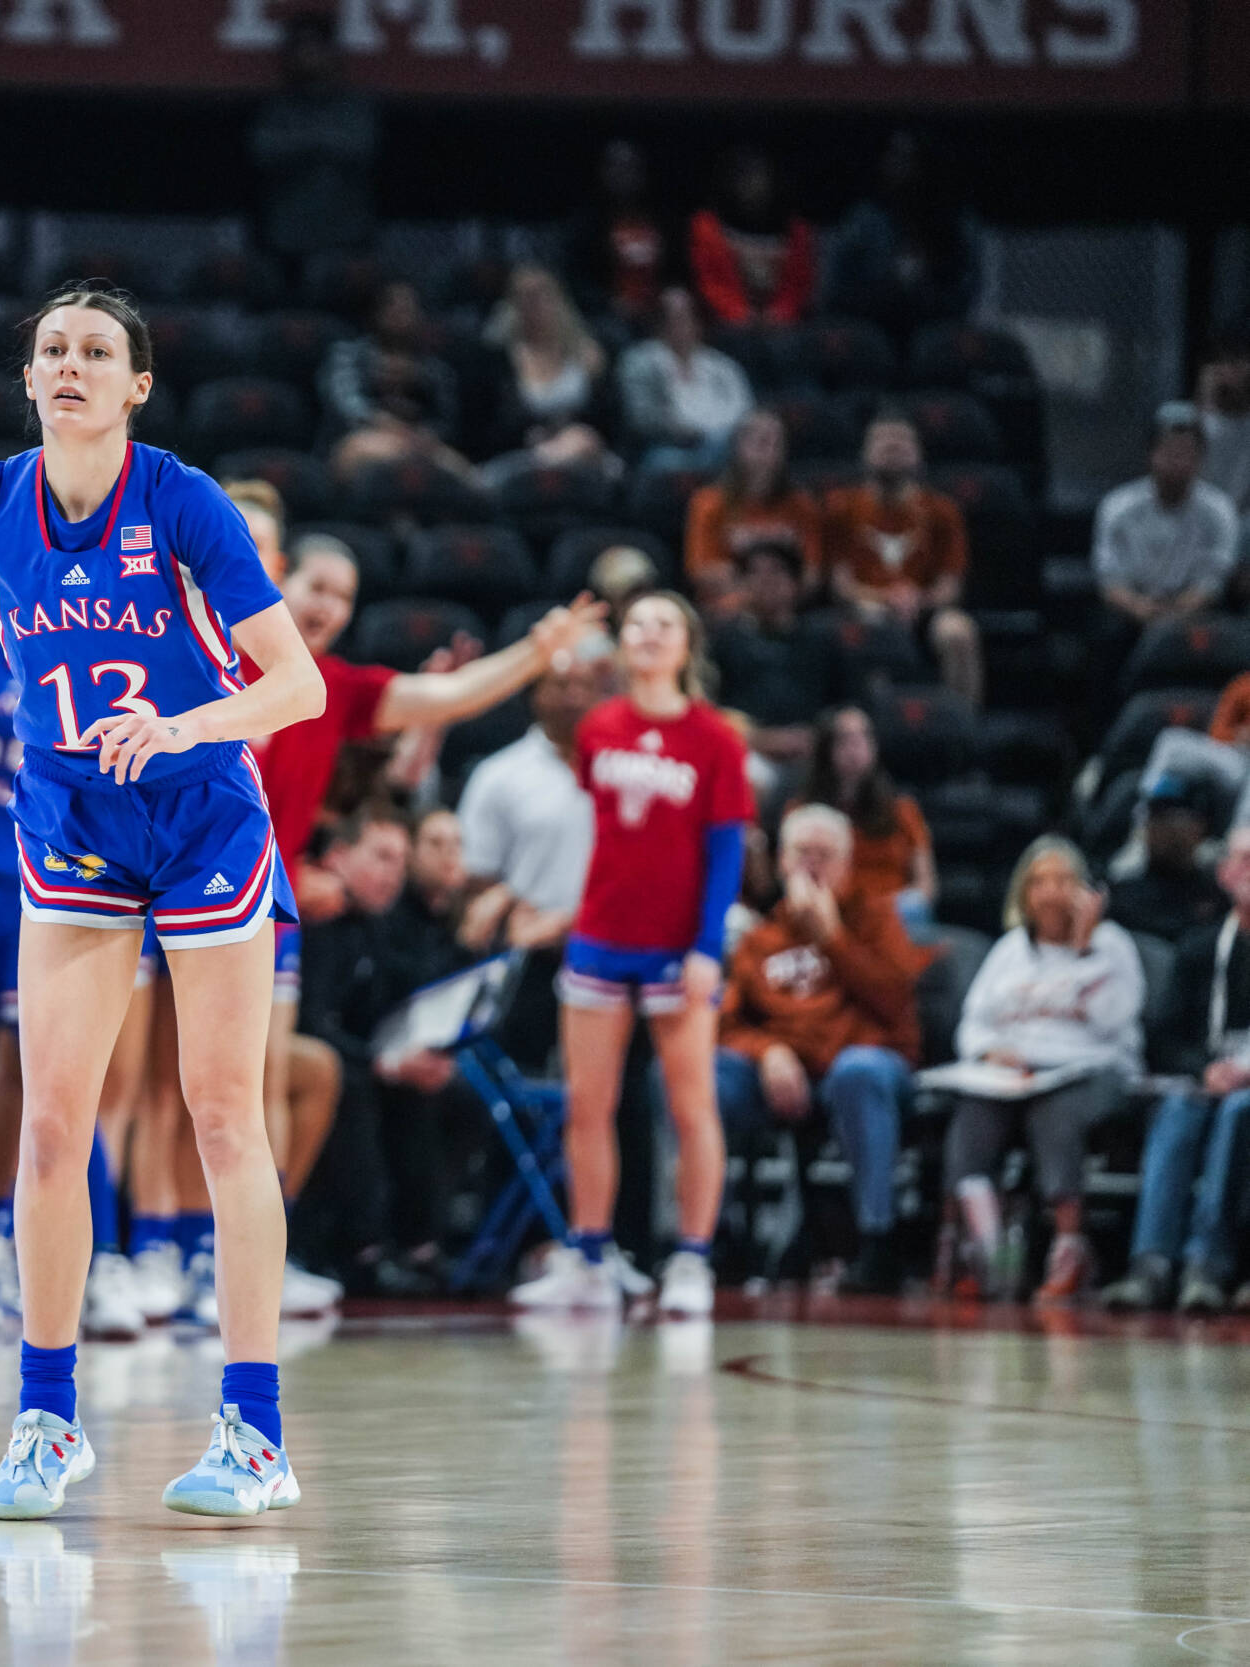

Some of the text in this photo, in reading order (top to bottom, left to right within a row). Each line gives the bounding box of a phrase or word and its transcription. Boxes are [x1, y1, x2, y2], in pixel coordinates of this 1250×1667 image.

[61, 577, 91, 586] adidas
[8, 598, 172, 640] KANSAS
[38, 659, 160, 752] 13
[203, 884, 235, 896] adidas
